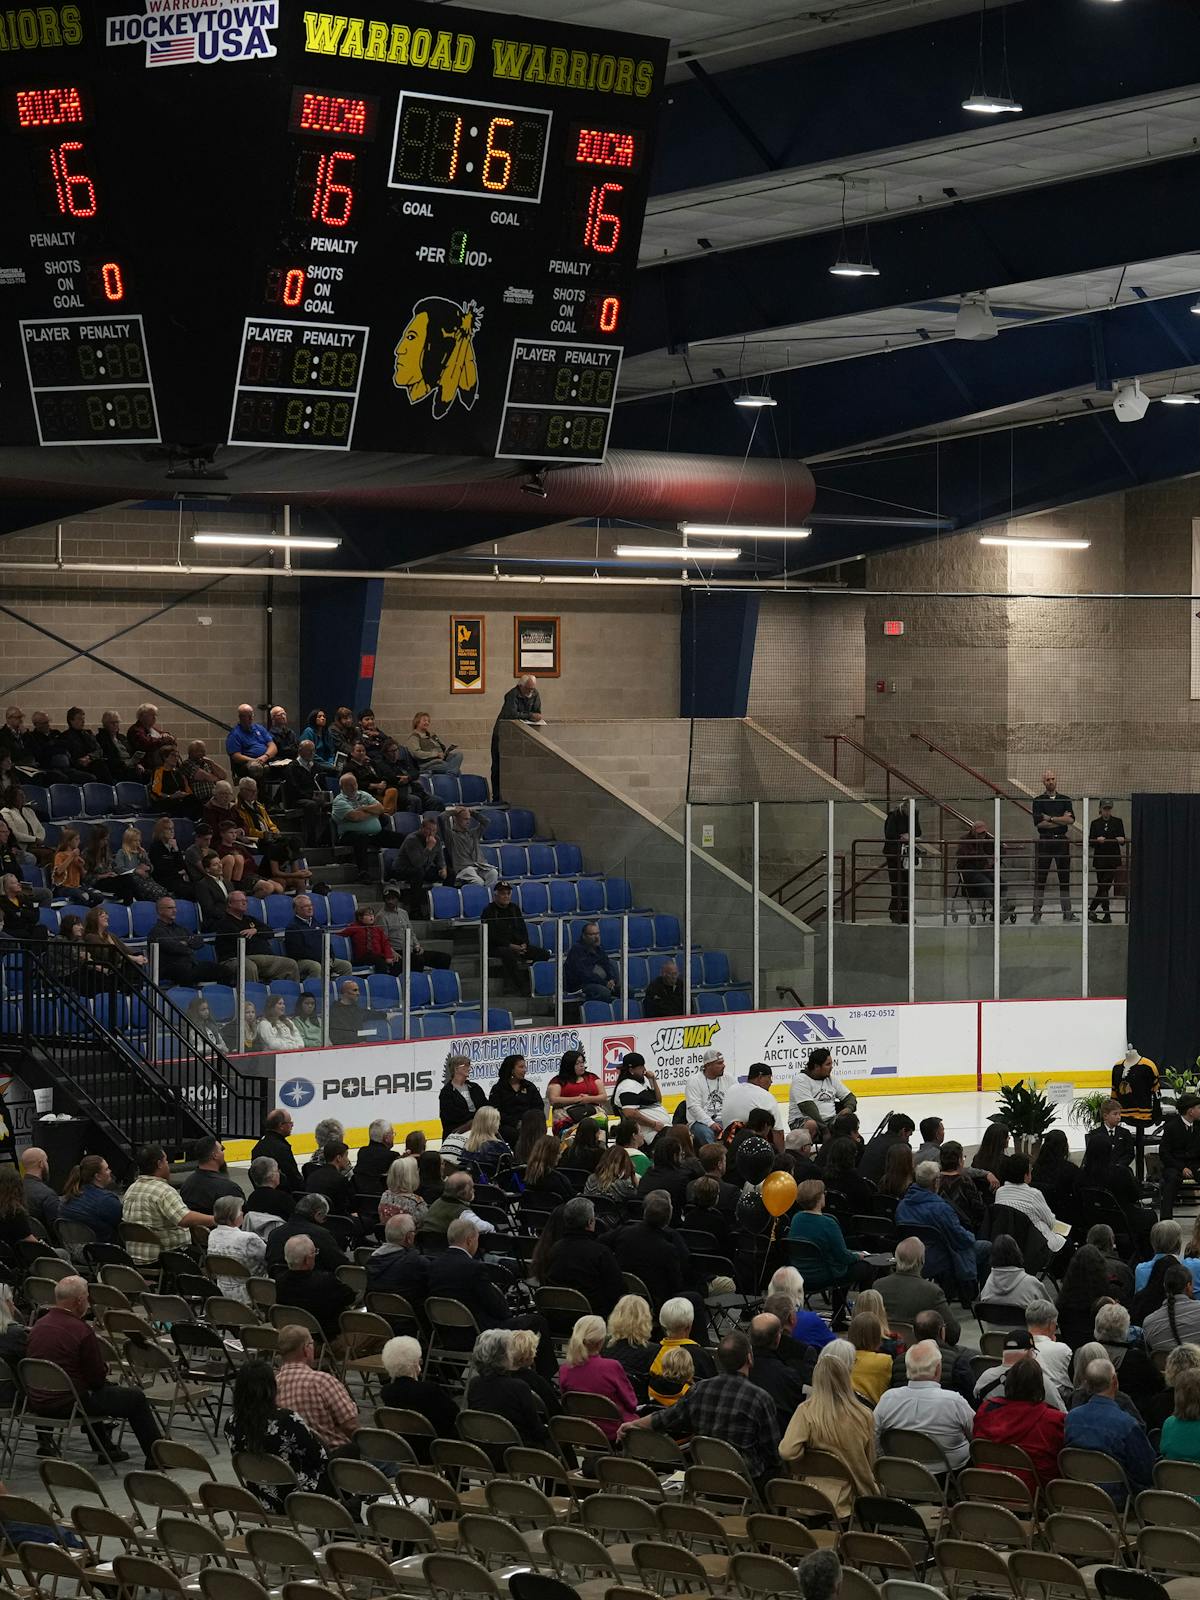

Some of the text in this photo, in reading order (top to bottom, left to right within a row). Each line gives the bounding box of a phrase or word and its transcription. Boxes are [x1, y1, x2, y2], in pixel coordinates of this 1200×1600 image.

[0, 5, 83, 50] IORS
[110, 4, 275, 41] HOCKEYTOWN
[198, 26, 268, 59] USA
[304, 11, 654, 97] WARROAD WARRIORS
[50, 142, 96, 217] 16
[311, 151, 355, 226] 16
[402, 201, 434, 218] GOAL
[584, 182, 624, 253] 16
[490, 211, 520, 226] GOAL
[30, 231, 75, 247] PENALTY
[310, 237, 358, 254] PENALTY
[44, 259, 81, 275] SHOTS
[306, 265, 343, 281] SHOTS
[549, 260, 591, 276] PENALTY
[57, 278, 74, 291] ON
[102, 263, 123, 300] 0
[283, 269, 304, 305] 0
[314, 282, 331, 297] ON
[53, 295, 84, 308] GOAL
[553, 288, 585, 302] SHOTS
[304, 299, 335, 314] GOAL
[559, 303, 574, 317] ON
[600, 297, 619, 331] 0
[25, 324, 130, 342] PLAYER PENALTY
[550, 320, 577, 333] GOAL
[247, 326, 355, 347] PLAYER PENALTY
[516, 346, 611, 366] PLAYER PENALTY
[849, 1009, 895, 1019] 218-452-0512
[451, 1030, 580, 1061] NORTHERN LIGHTS
[653, 1023, 717, 1053] SUBWAY
[657, 1055, 684, 1067] Order
[764, 1048, 798, 1061] ARCTIC
[836, 1044, 867, 1056] FOAM
[468, 1060, 501, 1080] AMILY
[322, 1070, 432, 1100] POLARIS
